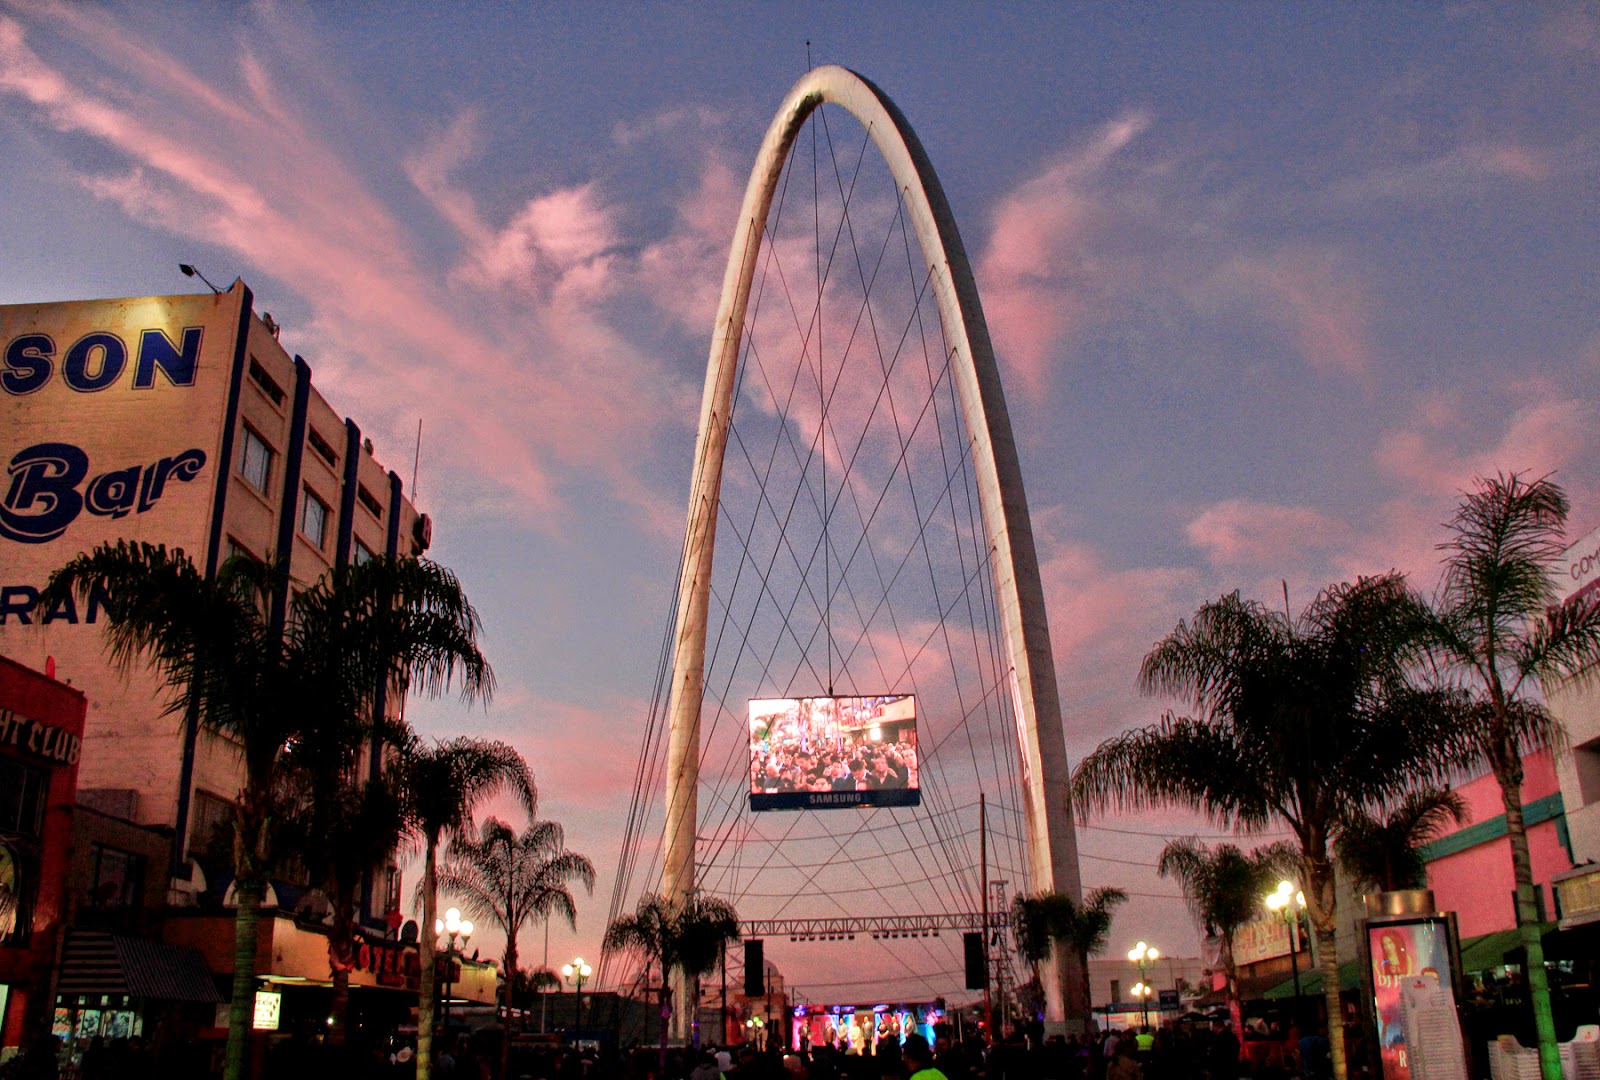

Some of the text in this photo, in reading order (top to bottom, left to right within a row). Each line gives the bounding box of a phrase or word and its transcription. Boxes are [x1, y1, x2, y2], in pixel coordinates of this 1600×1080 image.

[0, 325, 204, 396] SON
[0, 443, 206, 544] Bar
[28, 720, 81, 766] CLUB
[809, 793, 862, 805] SAMSUNG
[1378, 975, 1391, 988] DJ
